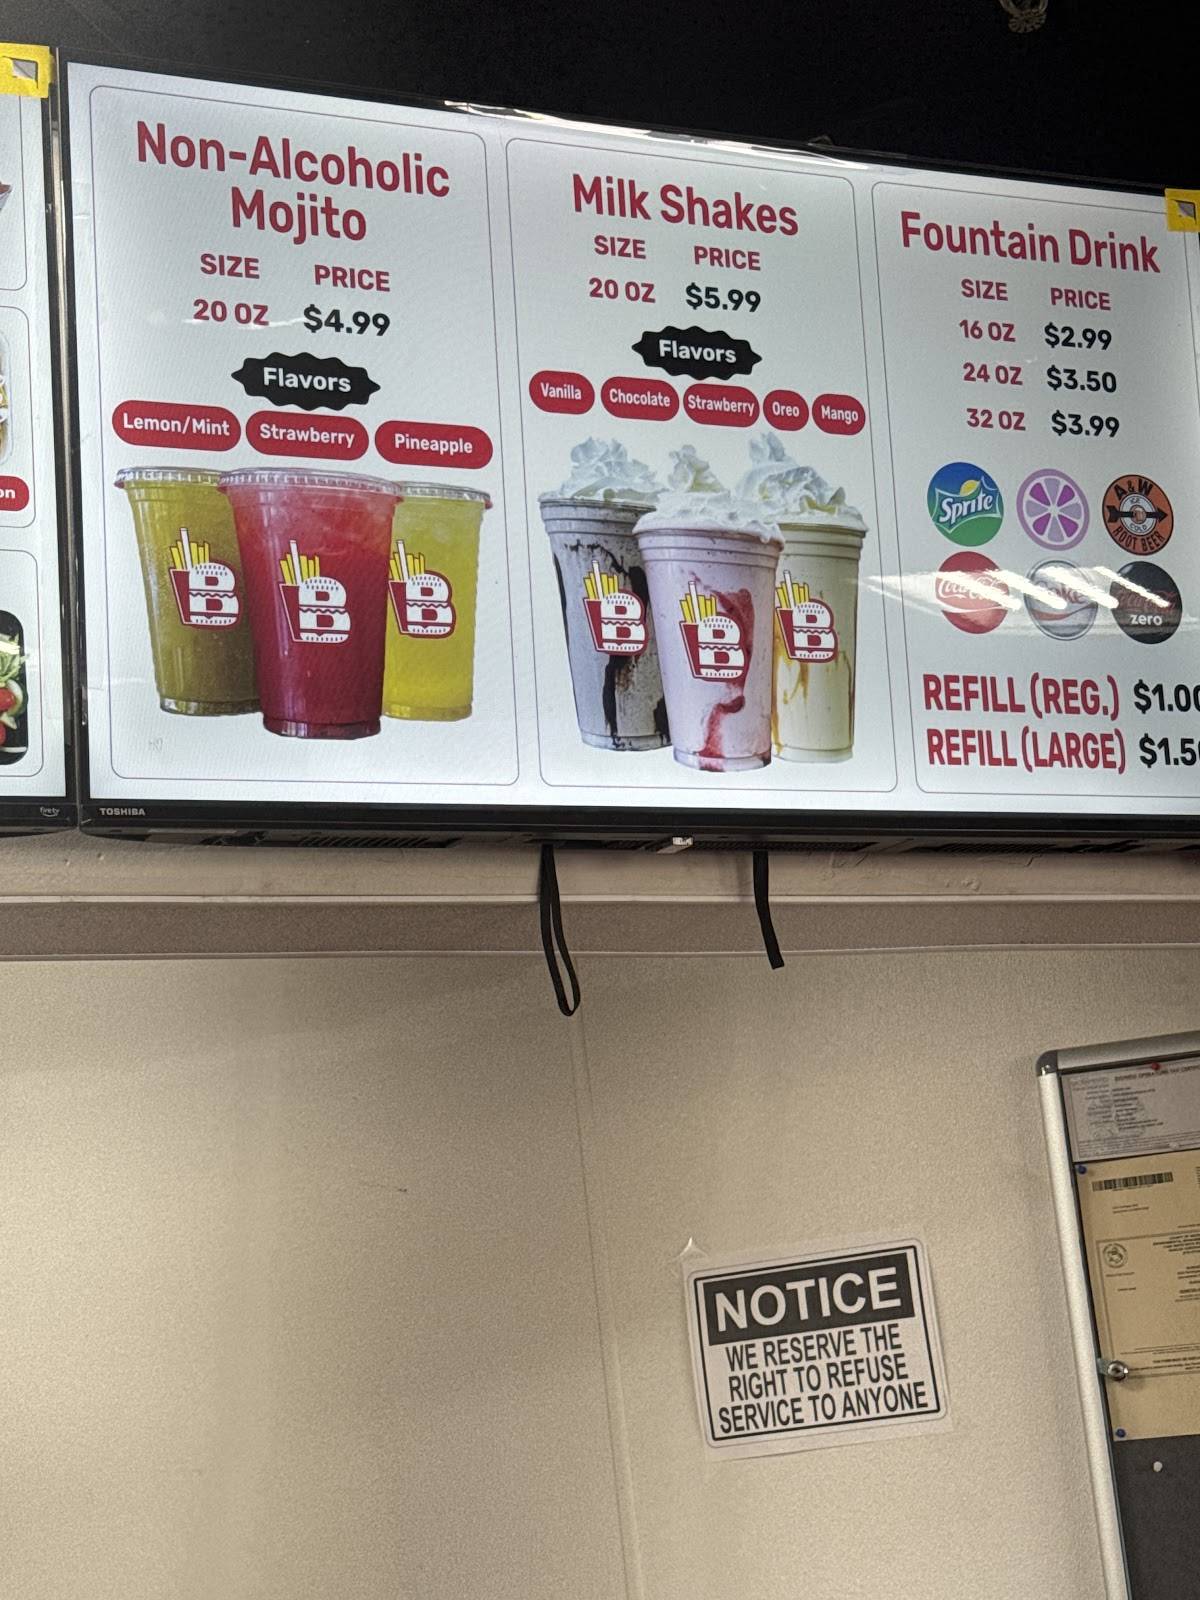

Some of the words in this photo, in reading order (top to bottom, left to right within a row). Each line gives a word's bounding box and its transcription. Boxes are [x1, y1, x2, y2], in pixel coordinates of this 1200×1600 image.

[137, 121, 450, 198] Non-Alcoholic
[231, 187, 367, 244] Mojito
[573, 173, 651, 219] Milk
[660, 183, 798, 235] Shakes
[594, 234, 646, 259] SIZE
[694, 244, 761, 271] PRICE
[901, 210, 1059, 262] Fountain
[1069, 228, 1160, 272] Drink
[201, 253, 259, 280] SIZE
[314, 263, 390, 292] PRICE
[589, 277, 619, 299] 20
[625, 282, 655, 304] OZ
[686, 282, 761, 312] $5.99
[961, 278, 1009, 300] SIZE
[1051, 288, 1111, 311] PRICE
[193, 298, 228, 322] 20
[234, 304, 269, 326] OZ
[304, 304, 390, 336] $4.99
[959, 320, 983, 340] 16
[988, 321, 1016, 342] OZ
[1045, 322, 1111, 350] $2.99
[659, 339, 737, 364] Flavors
[264, 366, 352, 393] Flavors
[540, 383, 582, 400] Vanilla
[963, 363, 990, 383] 24
[995, 366, 1023, 385] OZ
[1047, 365, 1116, 393] $3.50
[610, 389, 671, 408] Chocolate
[688, 395, 755, 417] Strawberry
[772, 402, 800, 418] Oreo
[123, 413, 230, 436] Lemon/Mint
[821, 406, 859, 425] Mango
[967, 408, 994, 429] 32
[997, 411, 1025, 432] OZ
[1052, 410, 1119, 437] $3.99
[260, 423, 355, 449] Strawberry
[394, 434, 473, 456] Pineapple
[939, 488, 993, 524] Sprite
[1113, 526, 1138, 550] ROOT
[1141, 531, 1166, 552] BEER
[1129, 614, 1163, 626] zero
[923, 673, 1026, 713] REFILL
[1031, 672, 1121, 720] (REG.)
[927, 728, 1017, 767] REFILL
[1022, 726, 1126, 773] (LARGE)
[1139, 733, 1200, 768] $1.5
[99, 807, 146, 816] TOSHIBA
[714, 1267, 902, 1332] NOTICE
[726, 1344, 758, 1372] WE
[763, 1329, 857, 1367] RESERVE
[859, 1323, 903, 1354] THE
[730, 1369, 788, 1402] RIGHT
[794, 1365, 821, 1393] TO
[826, 1353, 909, 1389] REFUSE
[719, 1397, 804, 1434] SERVICE
[809, 1393, 837, 1422] TO
[843, 1381, 929, 1418] ANYONE
